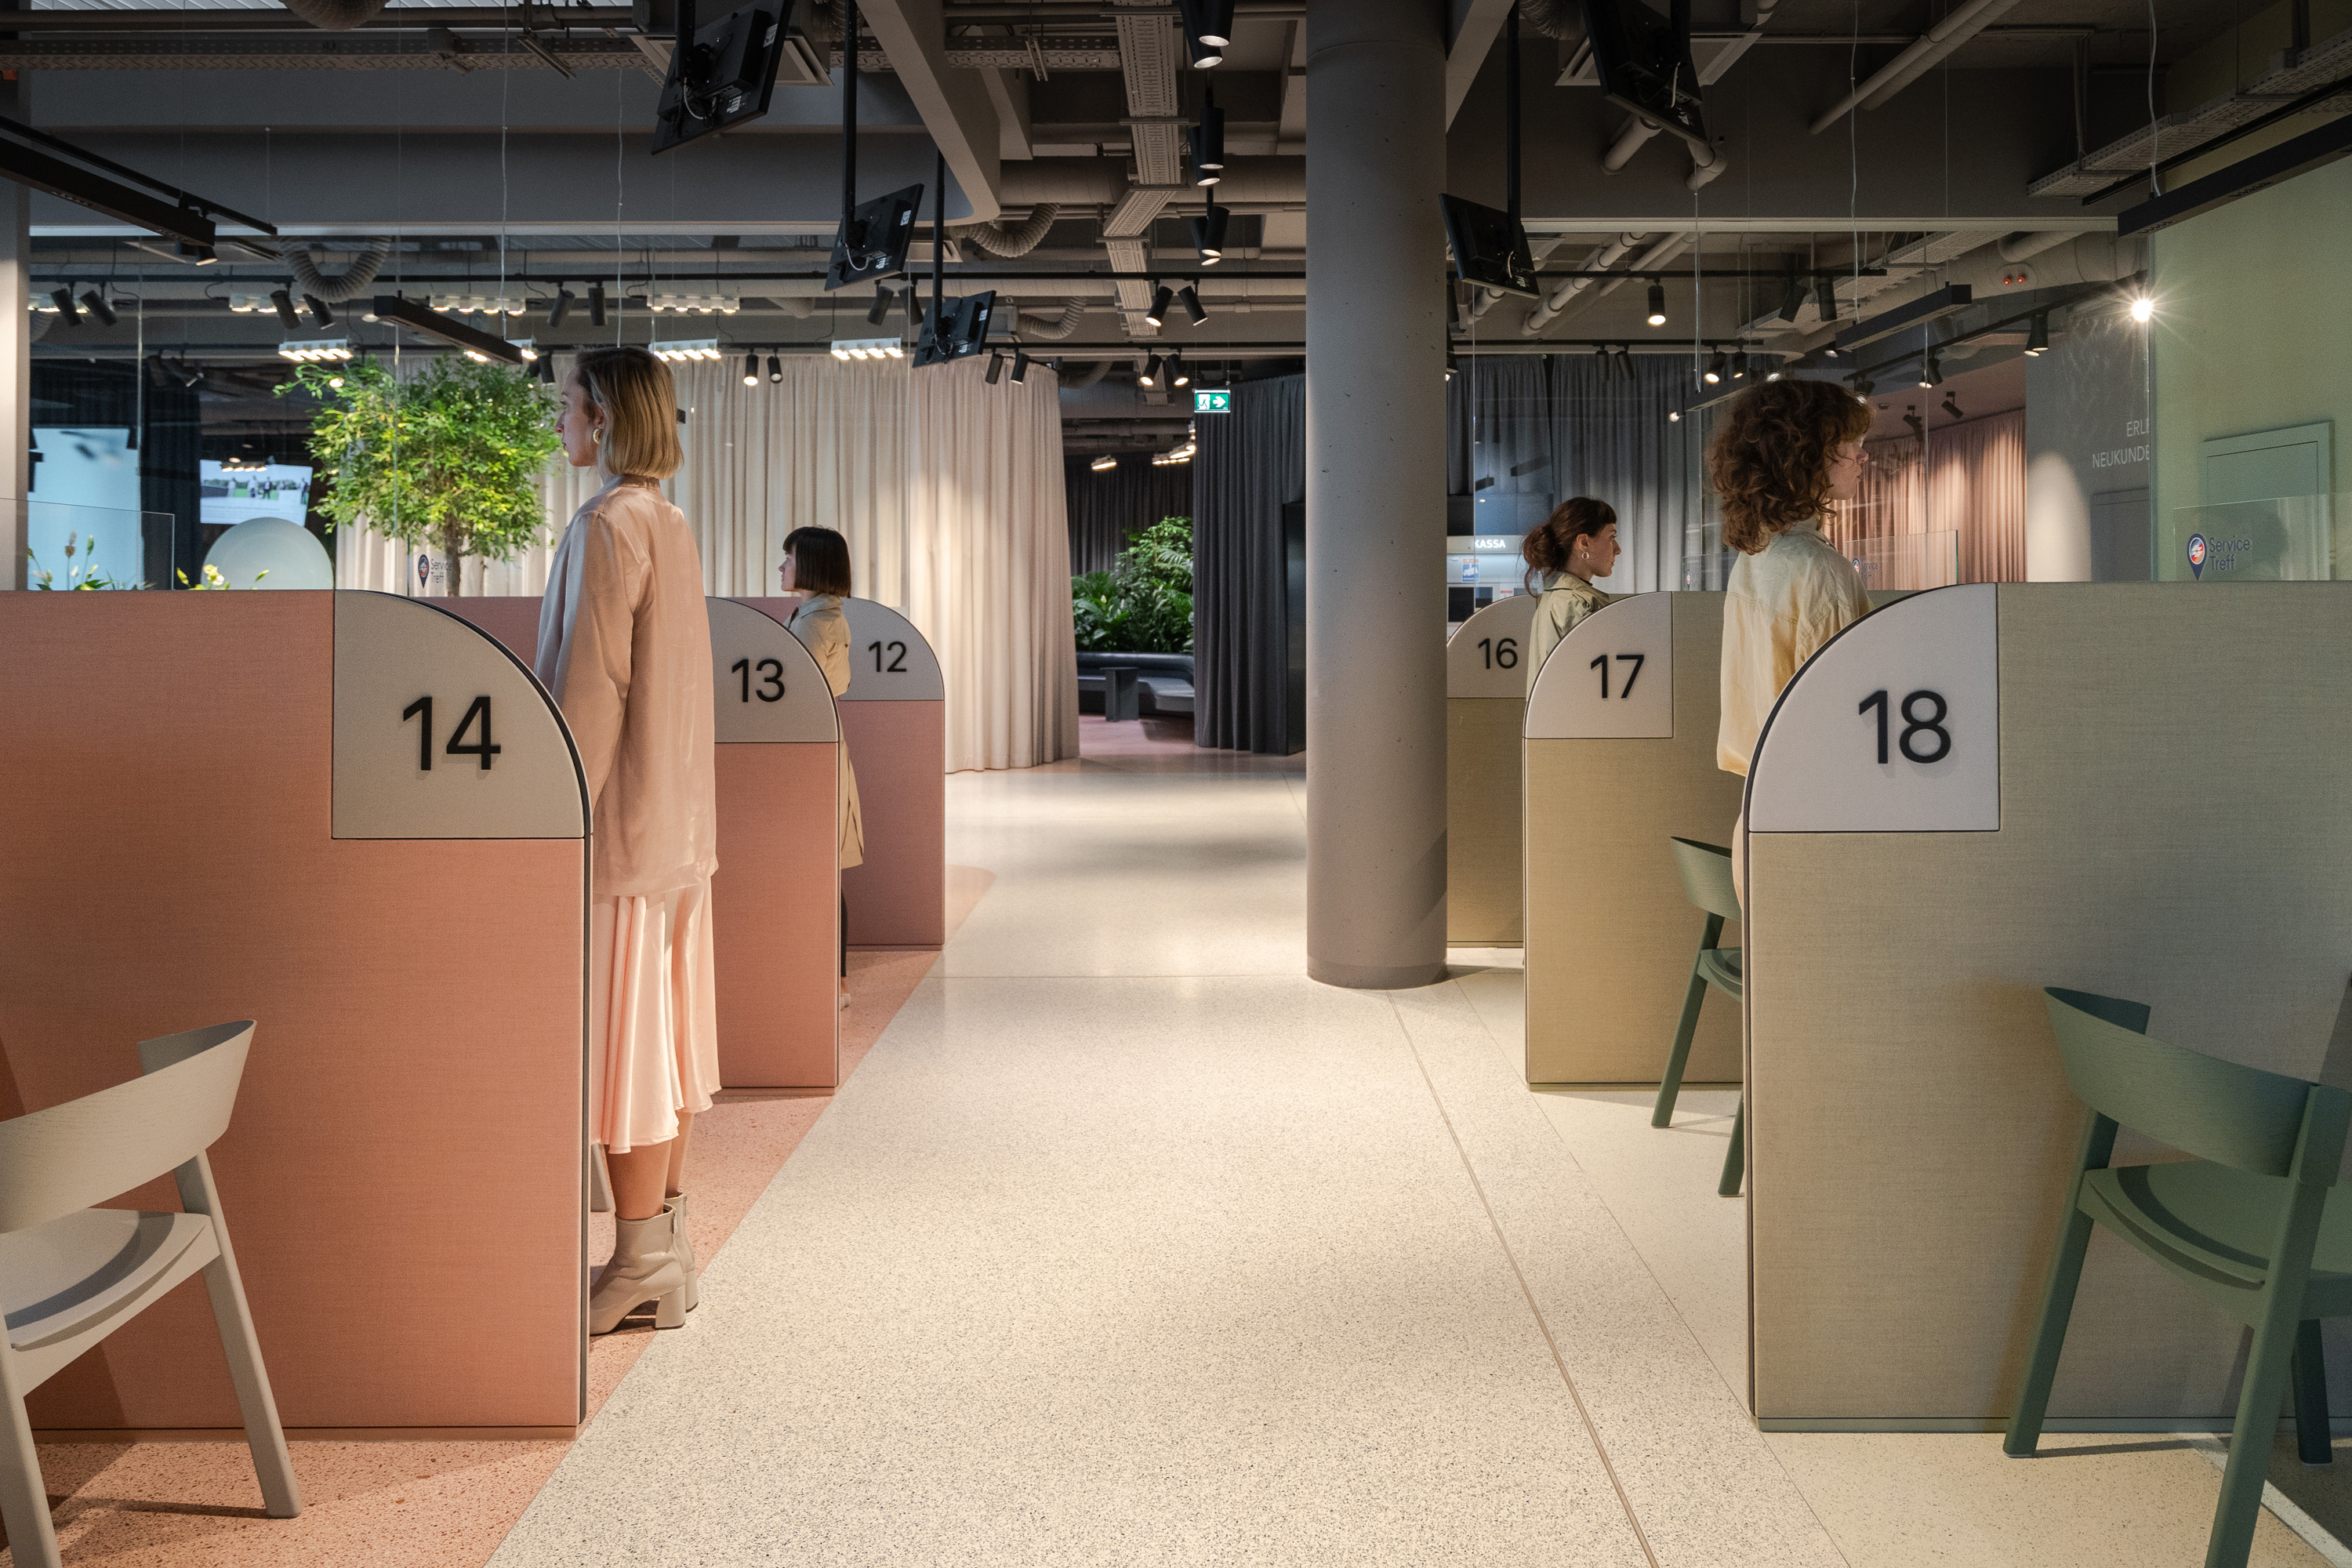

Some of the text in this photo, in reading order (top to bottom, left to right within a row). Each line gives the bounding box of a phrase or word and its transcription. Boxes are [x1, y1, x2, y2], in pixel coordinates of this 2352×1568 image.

[1475, 539, 1506, 549] KASSA
[2209, 535, 2251, 553] Service
[2209, 554, 2235, 572] Treff
[869, 641, 907, 673] 12
[1479, 638, 1519, 669] 16
[732, 659, 786, 703] 13
[1591, 655, 1645, 699] 17
[403, 695, 502, 771] 14
[1859, 690, 1951, 764] 18
